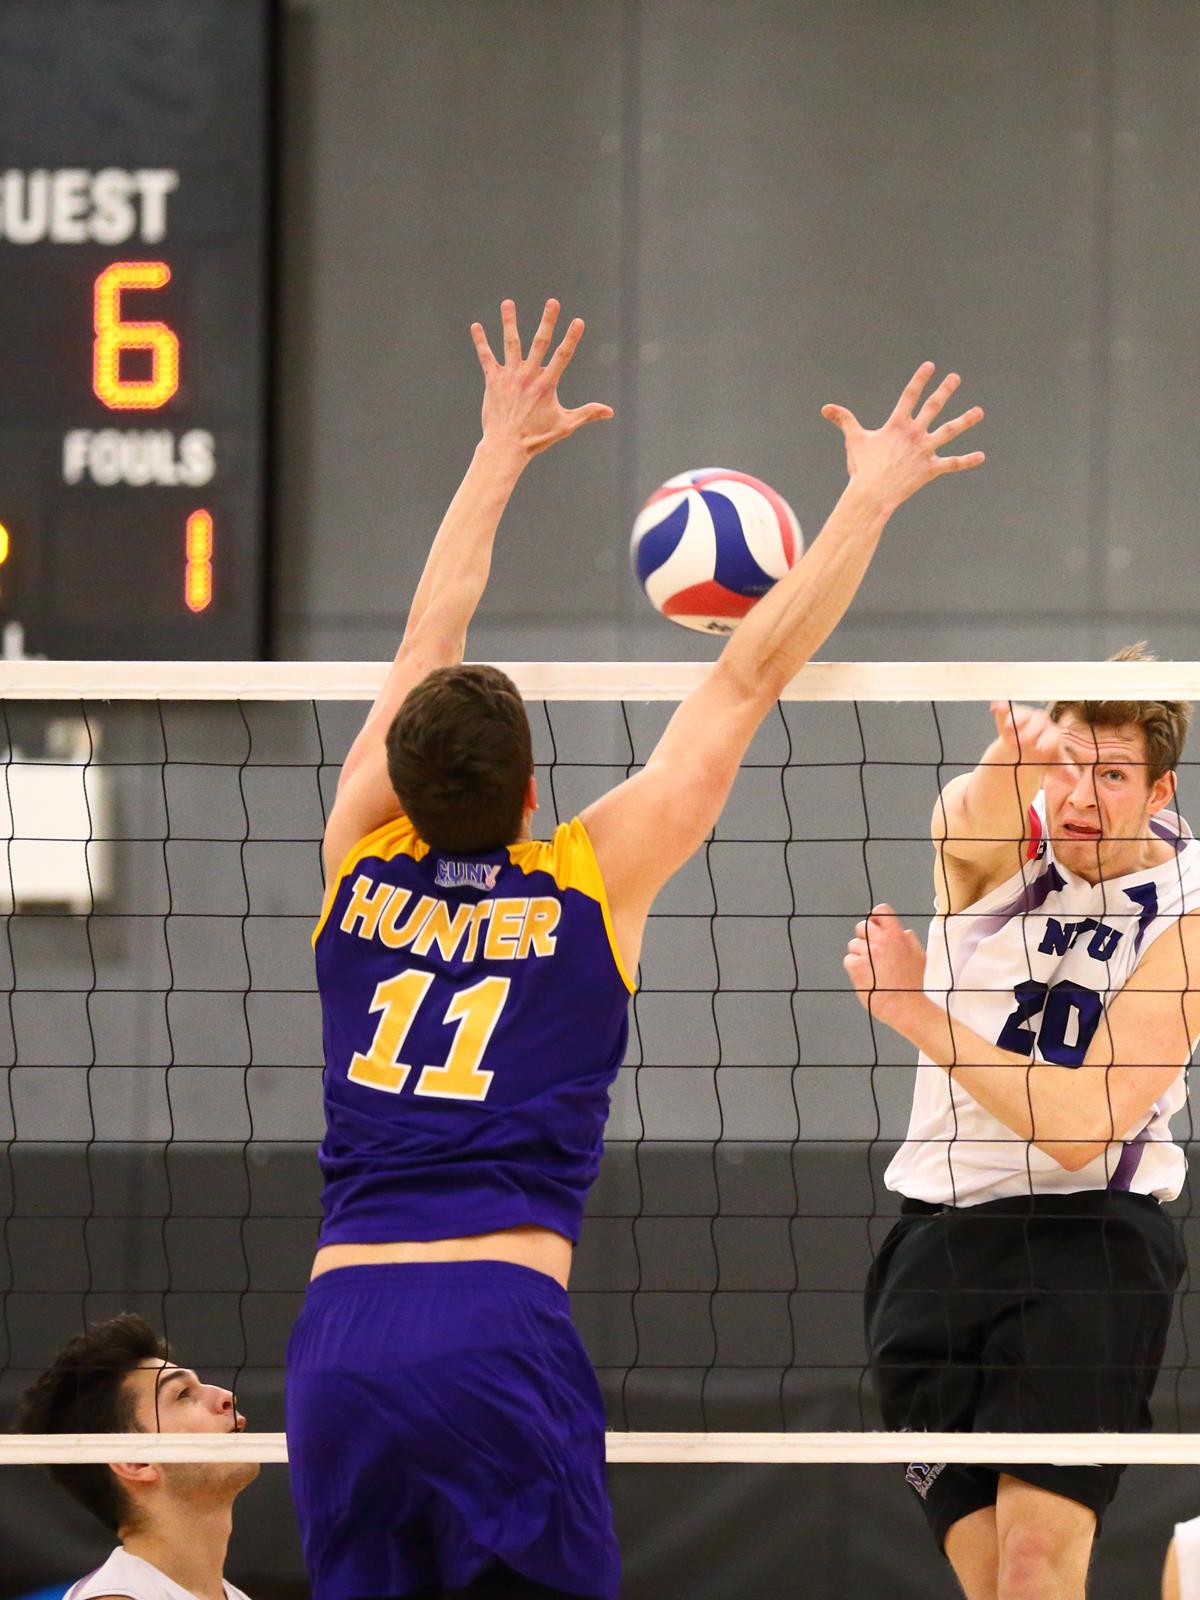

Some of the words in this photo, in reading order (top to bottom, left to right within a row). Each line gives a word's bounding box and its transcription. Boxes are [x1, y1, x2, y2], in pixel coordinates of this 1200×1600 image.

[0, 168, 179, 244] UEST
[93, 261, 180, 410] 6
[63, 429, 216, 486] FOULS
[185, 508, 212, 612] 1
[340, 874, 562, 962] HUNTER
[436, 859, 502, 889] CUNY
[347, 968, 511, 1101] 11
[996, 979, 1103, 1069] 20
